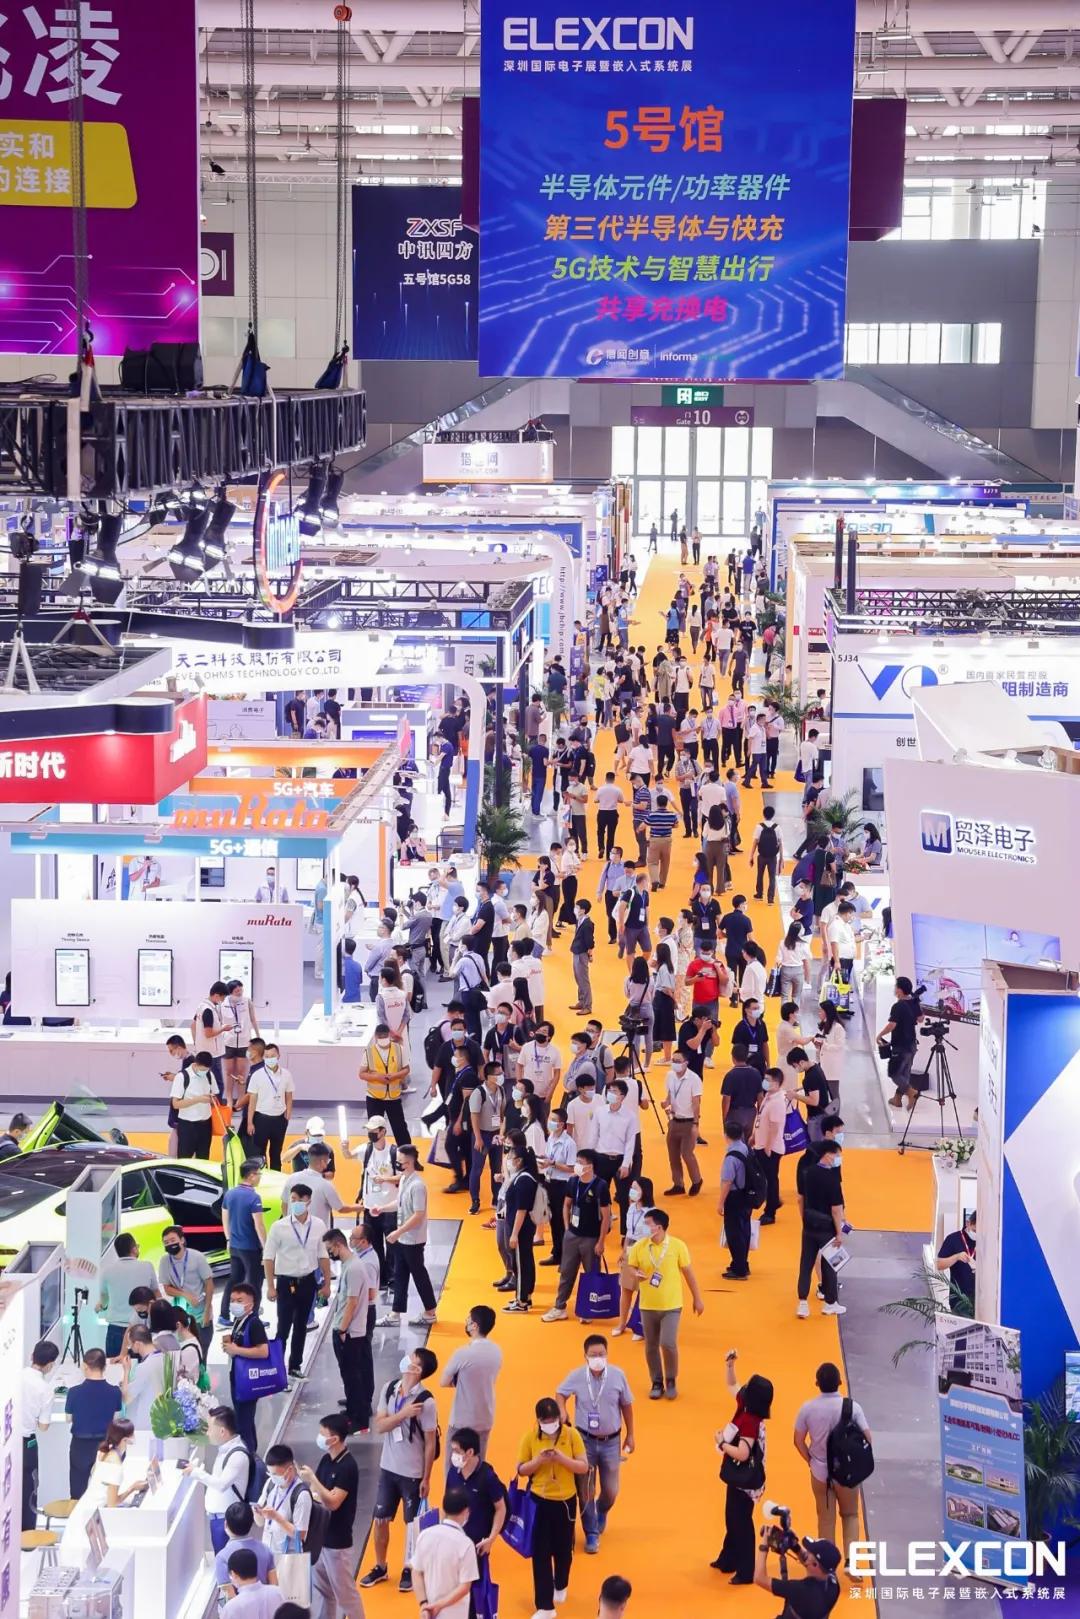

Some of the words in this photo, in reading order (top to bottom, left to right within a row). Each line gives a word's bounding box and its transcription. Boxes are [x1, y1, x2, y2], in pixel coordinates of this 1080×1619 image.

[503, 17, 694, 50] ELEXCON
[0, 2, 123, 105] 凌
[503, 60, 693, 72] 深圳国际电子展暨嵌入式系统展
[604, 105, 724, 152] 5号馆
[539, 174, 791, 203] 半导体元件/功率器件
[543, 214, 785, 241] 第三代半导体与快充
[398, 241, 474, 260] 中讯四方
[403, 274, 471, 286] 五号馆5G58
[552, 255, 774, 282] 5G技术与智慧出行
[596, 295, 730, 322] 共享充换电
[694, 410, 711, 425] 10
[176, 650, 342, 668] 天二科技股份有限公司
[203, 670, 234, 680] OHMS
[237, 667, 302, 679] TECHNOLOGY
[896, 737, 916, 747] 创世
[173, 793, 329, 831] muRata
[956, 820, 1034, 851] 贸泽电子
[957, 847, 987, 857] MOUSER
[987, 851, 1035, 863] ELECTRONICS
[247, 914, 292, 926] muRata
